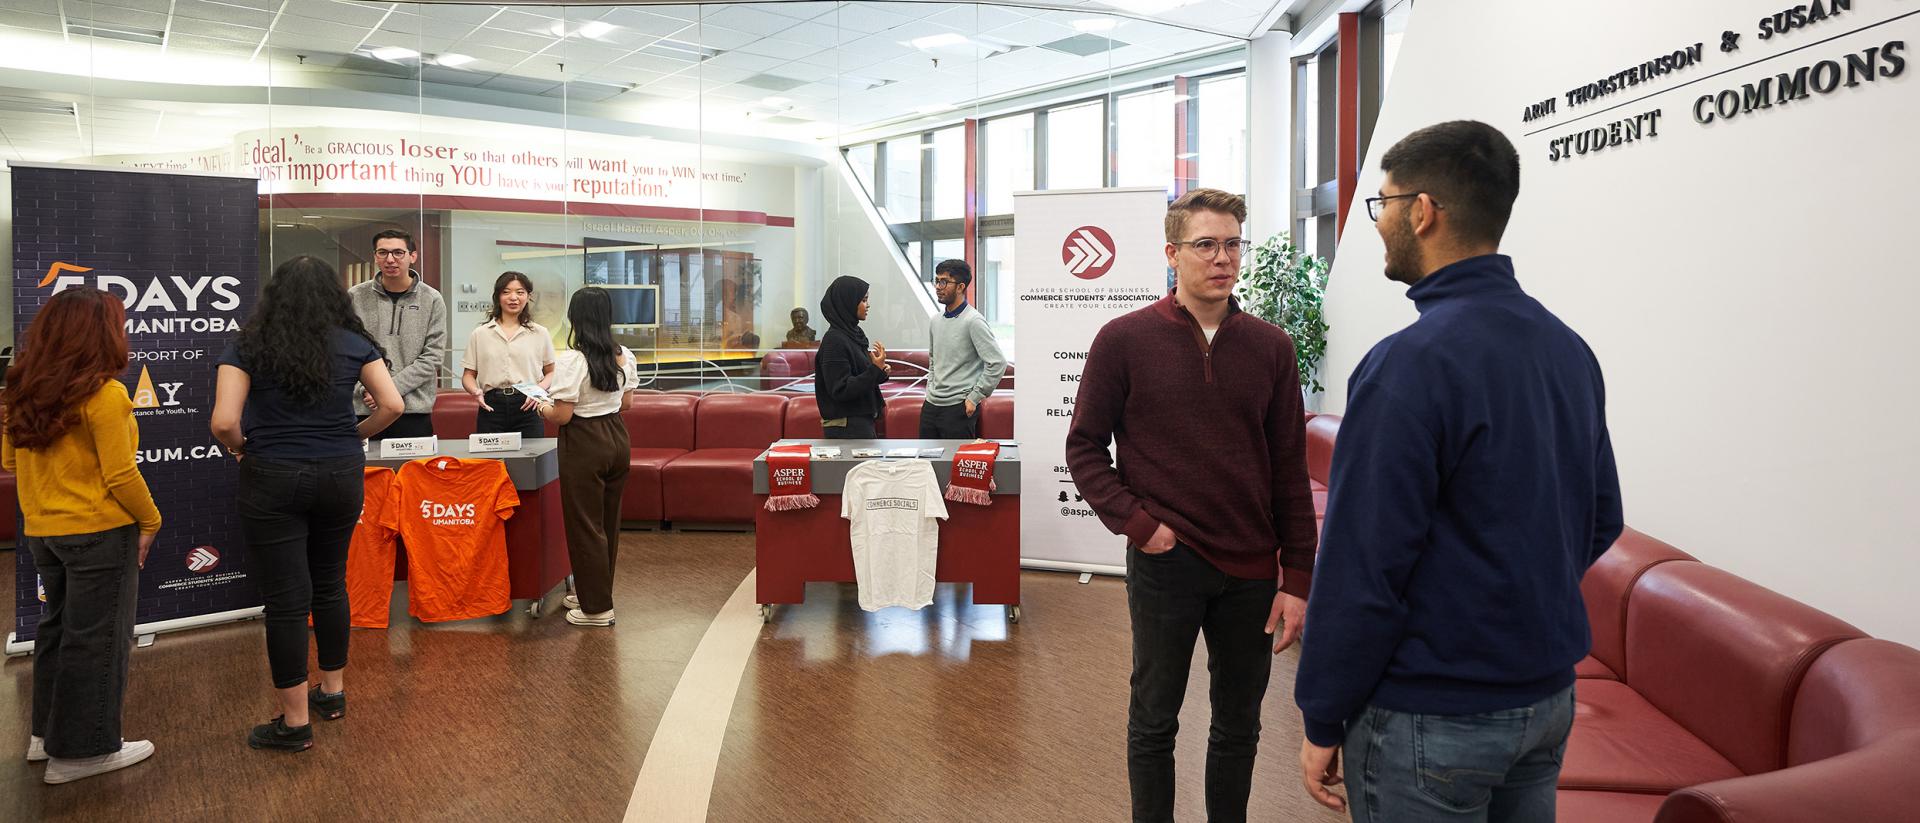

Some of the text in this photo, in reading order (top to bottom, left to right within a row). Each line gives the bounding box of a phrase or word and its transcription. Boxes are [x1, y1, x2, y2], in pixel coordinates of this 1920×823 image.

[1522, 0, 1851, 122] ARNI THORSTEINSON & SUSAN
[1549, 40, 1906, 161] STUDENT COMMONS
[327, 142, 394, 156] GRACIOUS
[400, 138, 459, 160] loser
[463, 151, 477, 161] so
[482, 150, 505, 163] that
[511, 150, 558, 168] others
[565, 156, 583, 169] will
[588, 158, 627, 173] want
[633, 165, 654, 177] you
[658, 166, 669, 176] to
[672, 165, 695, 179] WIN
[288, 160, 398, 187] important
[405, 166, 444, 187] thing
[449, 164, 492, 187] YOU
[498, 172, 529, 188] have
[97, 275, 241, 312] DAYS
[123, 317, 241, 334] MANITOBA
[127, 349, 204, 361] PPORT OF
[1053, 351, 1089, 360] CONNE
[1046, 408, 1073, 417] RELA
[136, 445, 223, 464] SUM.CA
[773, 468, 805, 477] ASPER
[957, 458, 988, 470] ASPER
[1053, 465, 1071, 475] asp
[421, 502, 475, 519] 5 DAYS
[432, 518, 475, 526] UMANITOBA
